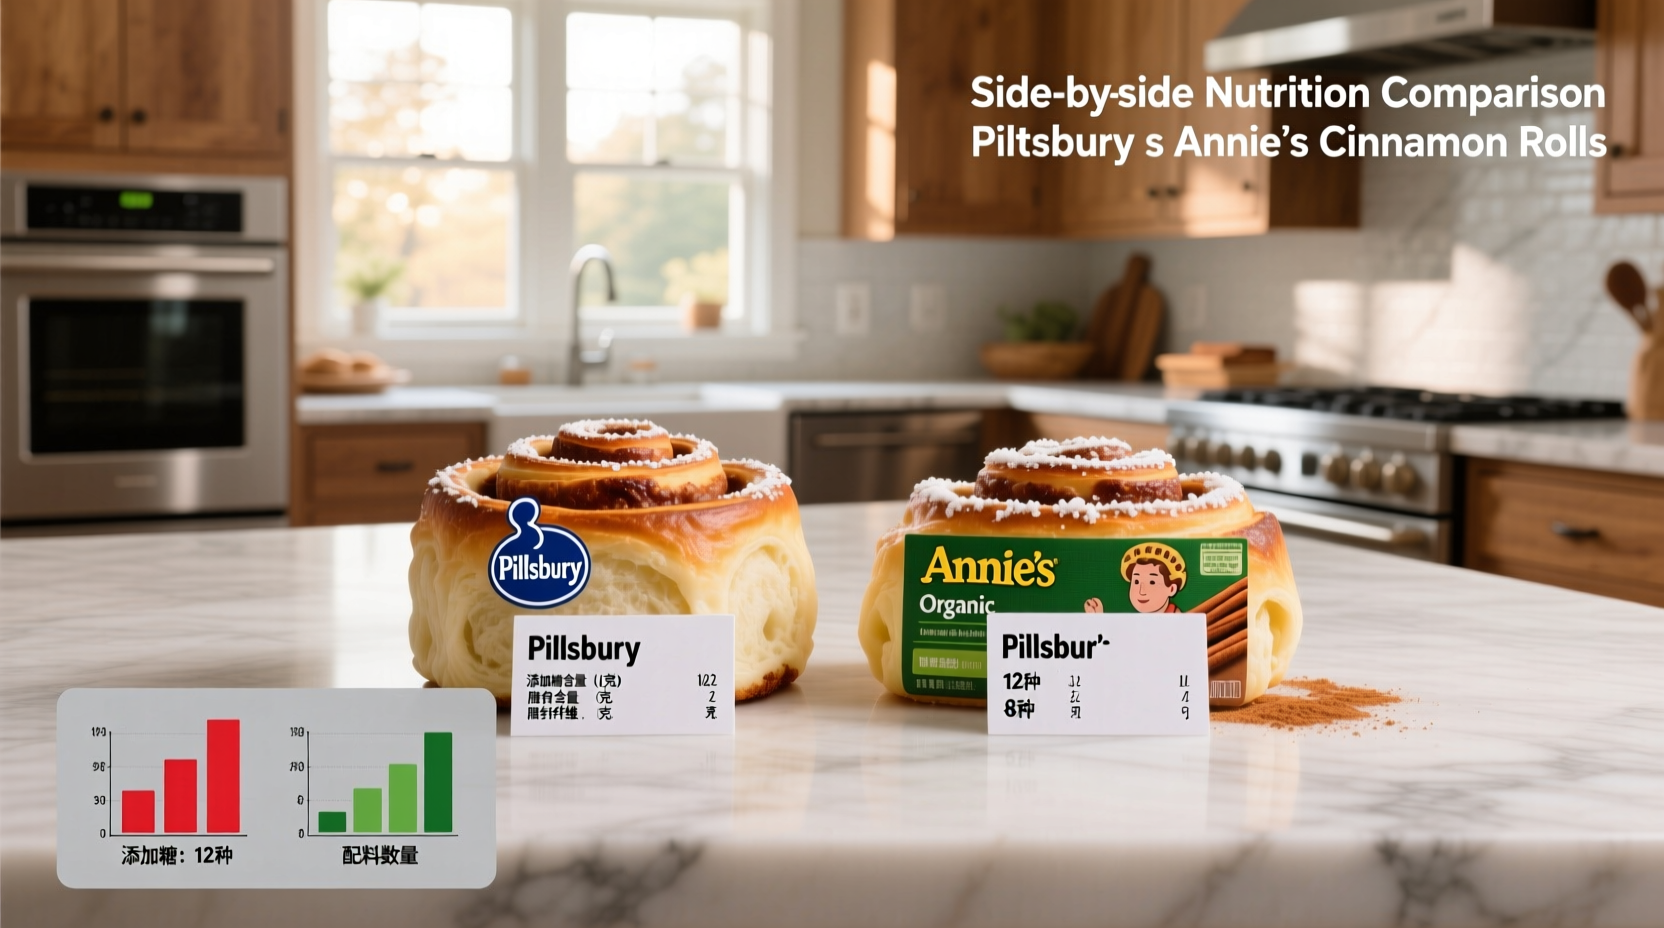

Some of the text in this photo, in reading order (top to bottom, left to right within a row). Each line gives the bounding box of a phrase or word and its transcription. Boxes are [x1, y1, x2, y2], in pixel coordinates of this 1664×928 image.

[499, 554, 583, 587] Pillsbury
[920, 545, 1056, 587] Annie's
[919, 594, 996, 620] Organic
[528, 634, 641, 668] Pillsbury
